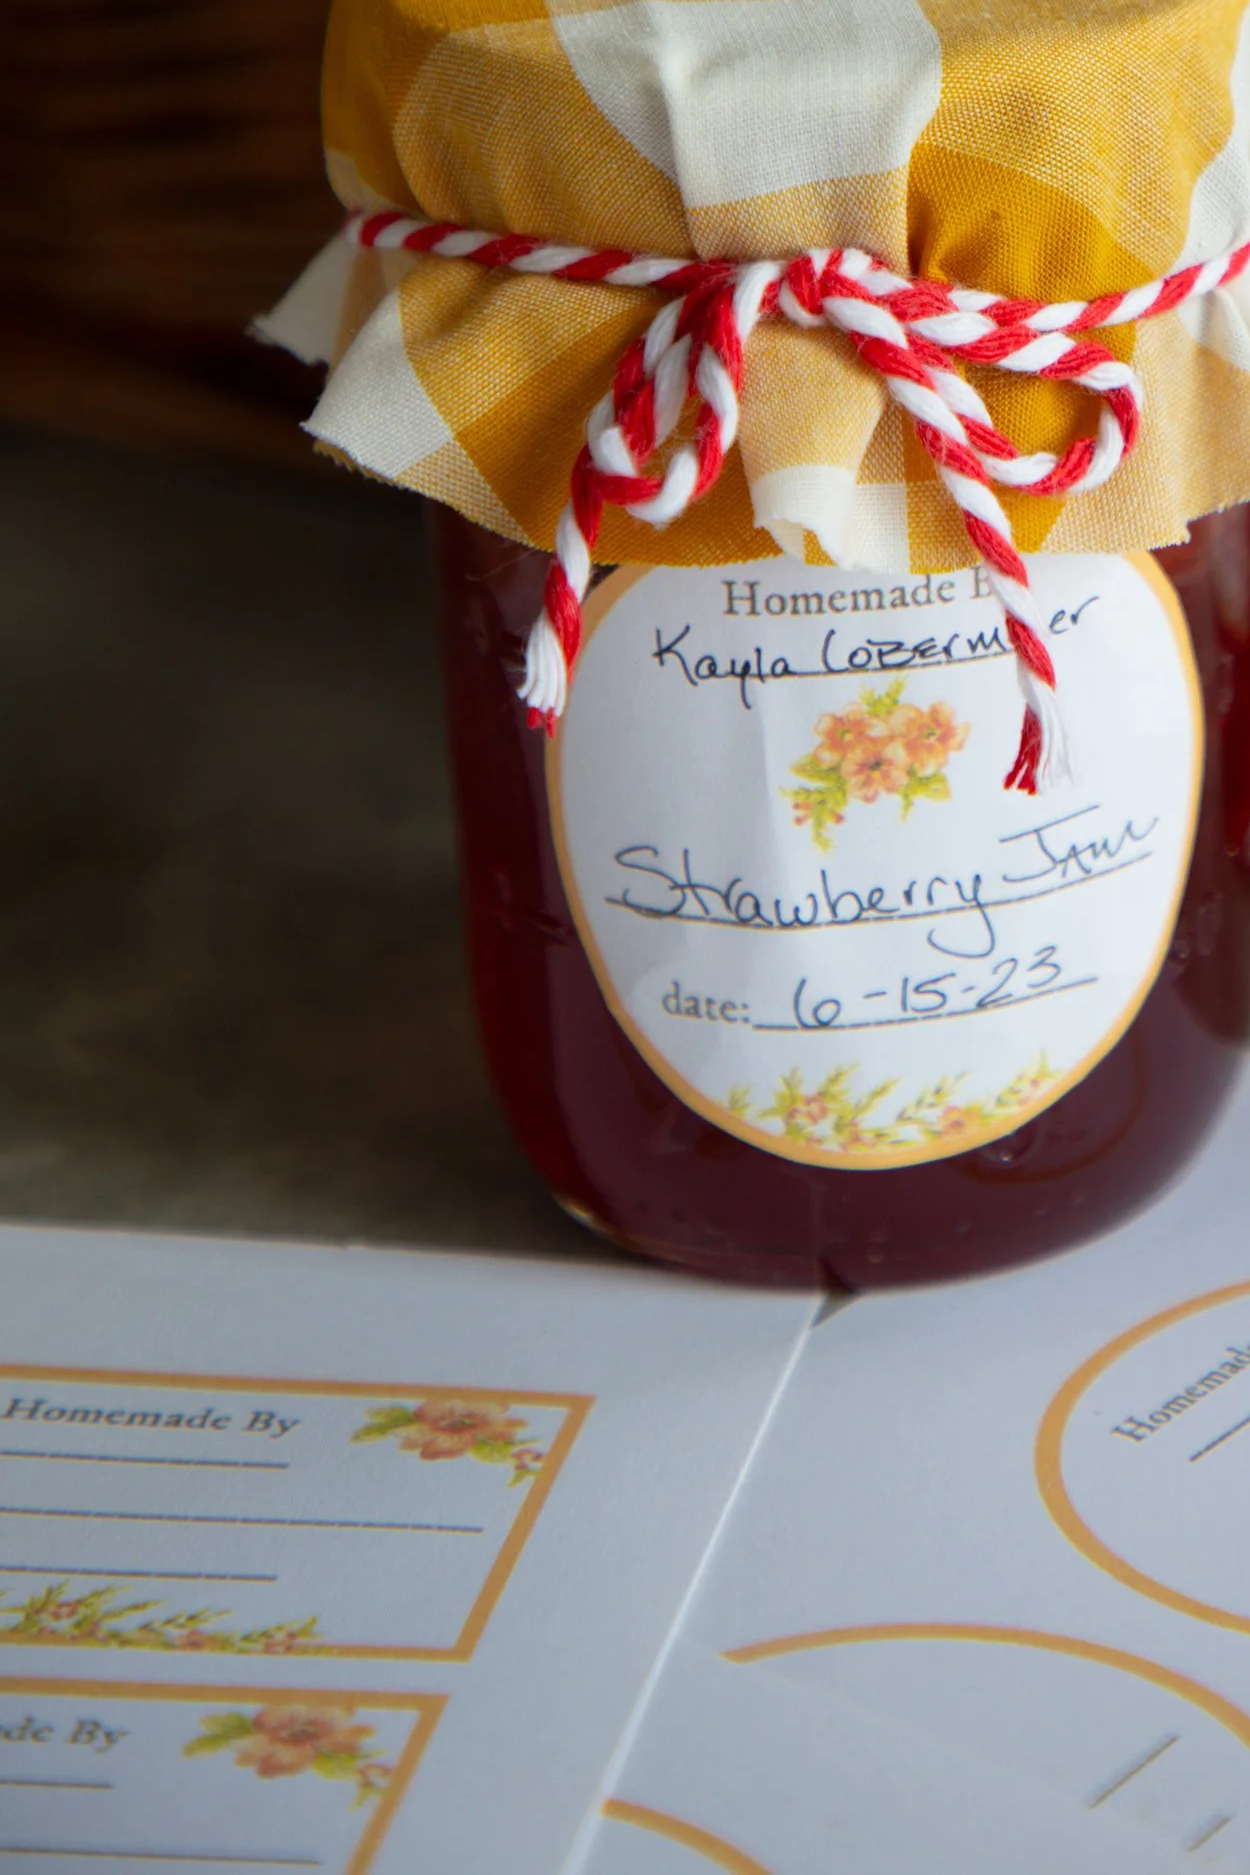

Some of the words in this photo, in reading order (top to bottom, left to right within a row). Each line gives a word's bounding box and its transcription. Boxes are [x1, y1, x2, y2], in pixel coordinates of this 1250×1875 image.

[722, 573, 956, 617] Homemade
[970, 565, 994, 599] B
[652, 625, 800, 710] Kayla
[614, 845, 996, 957] Strawberry
[662, 982, 750, 1023] date:
[794, 946, 1062, 1028] 6-15-23
[1, 1397, 232, 1432] Homemade
[243, 1409, 301, 1439] By
[67, 1718, 132, 1756] By
